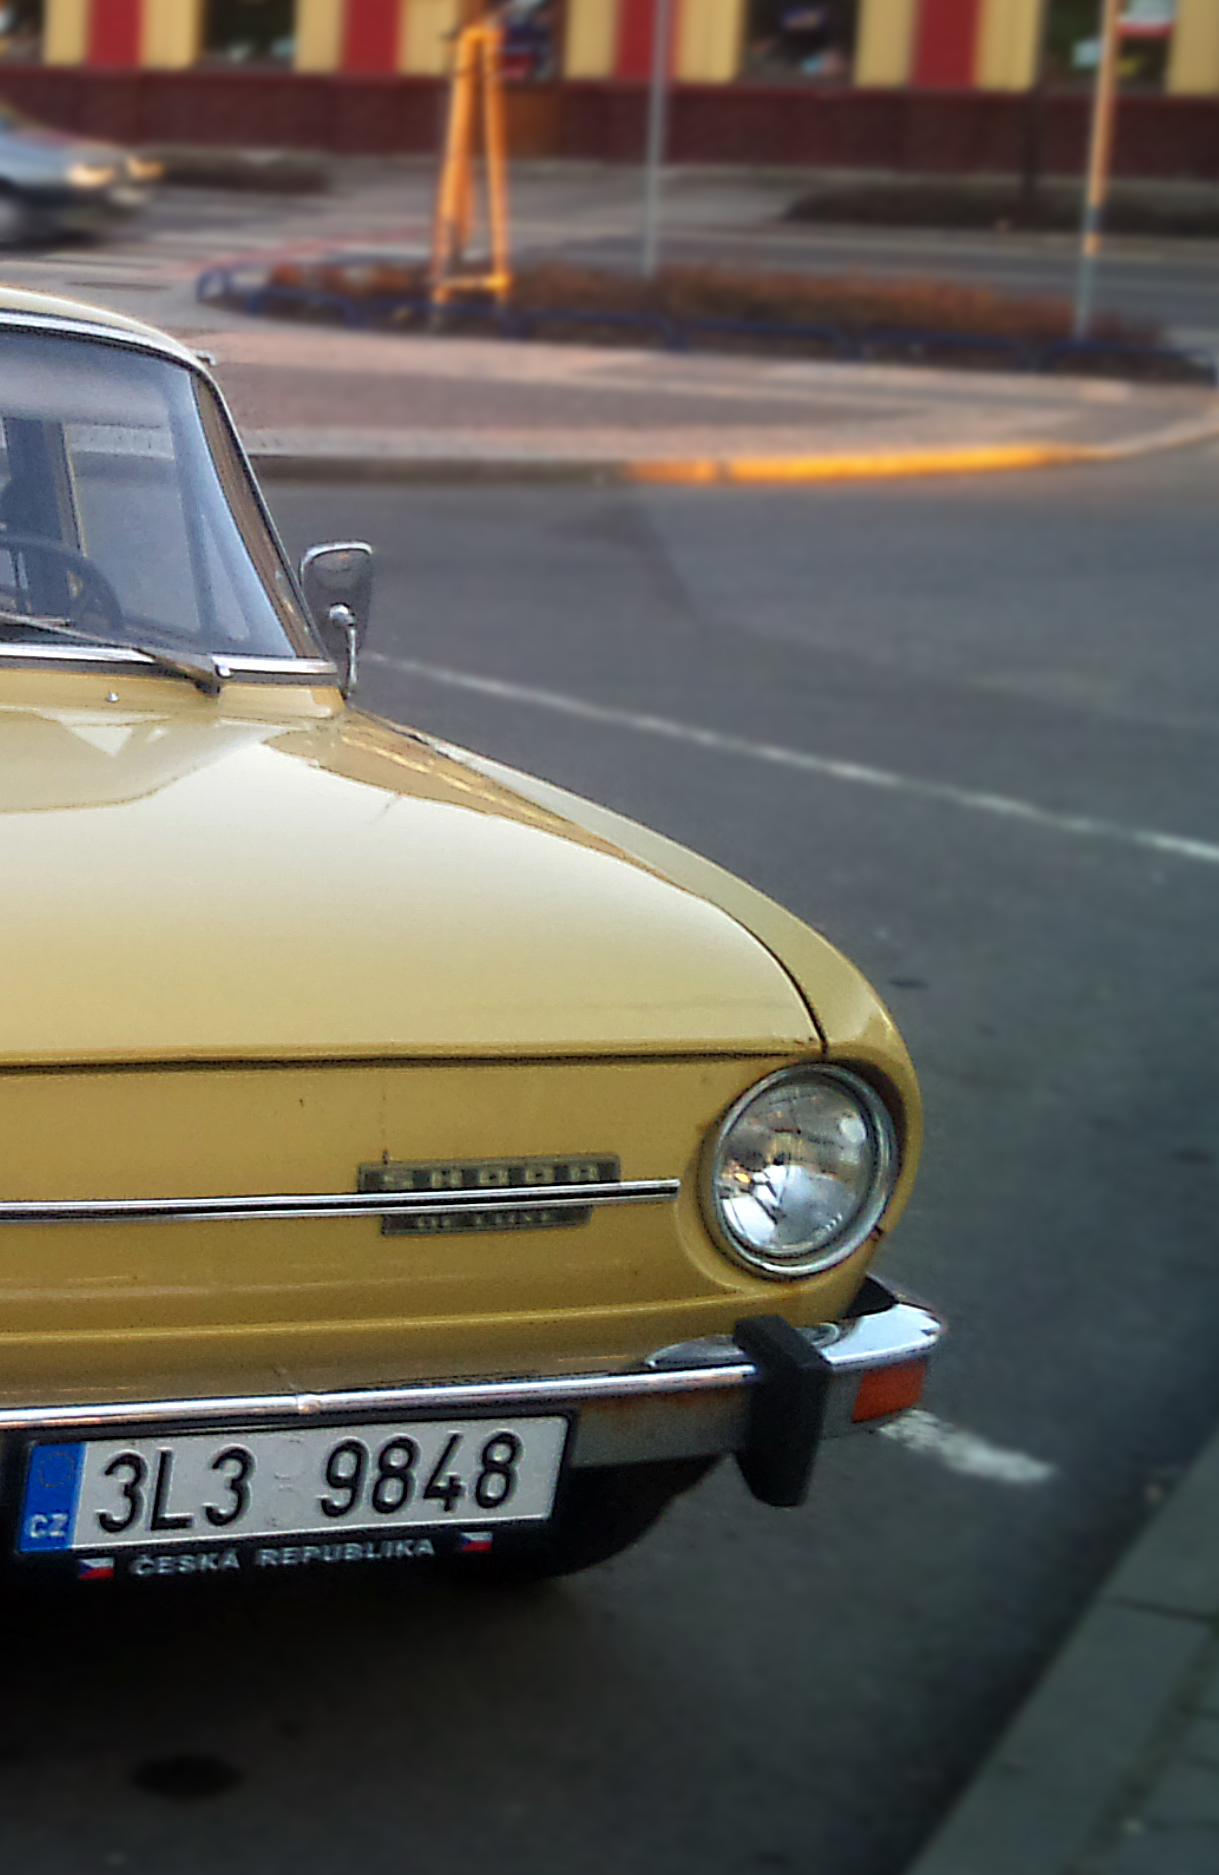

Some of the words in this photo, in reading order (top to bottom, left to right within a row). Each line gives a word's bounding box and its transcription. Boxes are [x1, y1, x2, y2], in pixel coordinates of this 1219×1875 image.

[96, 1446, 252, 1532] 3L3
[317, 1430, 522, 1518] 9848
[30, 1513, 68, 1538] CZ
[256, 1538, 436, 1568] REPUBLIKA
